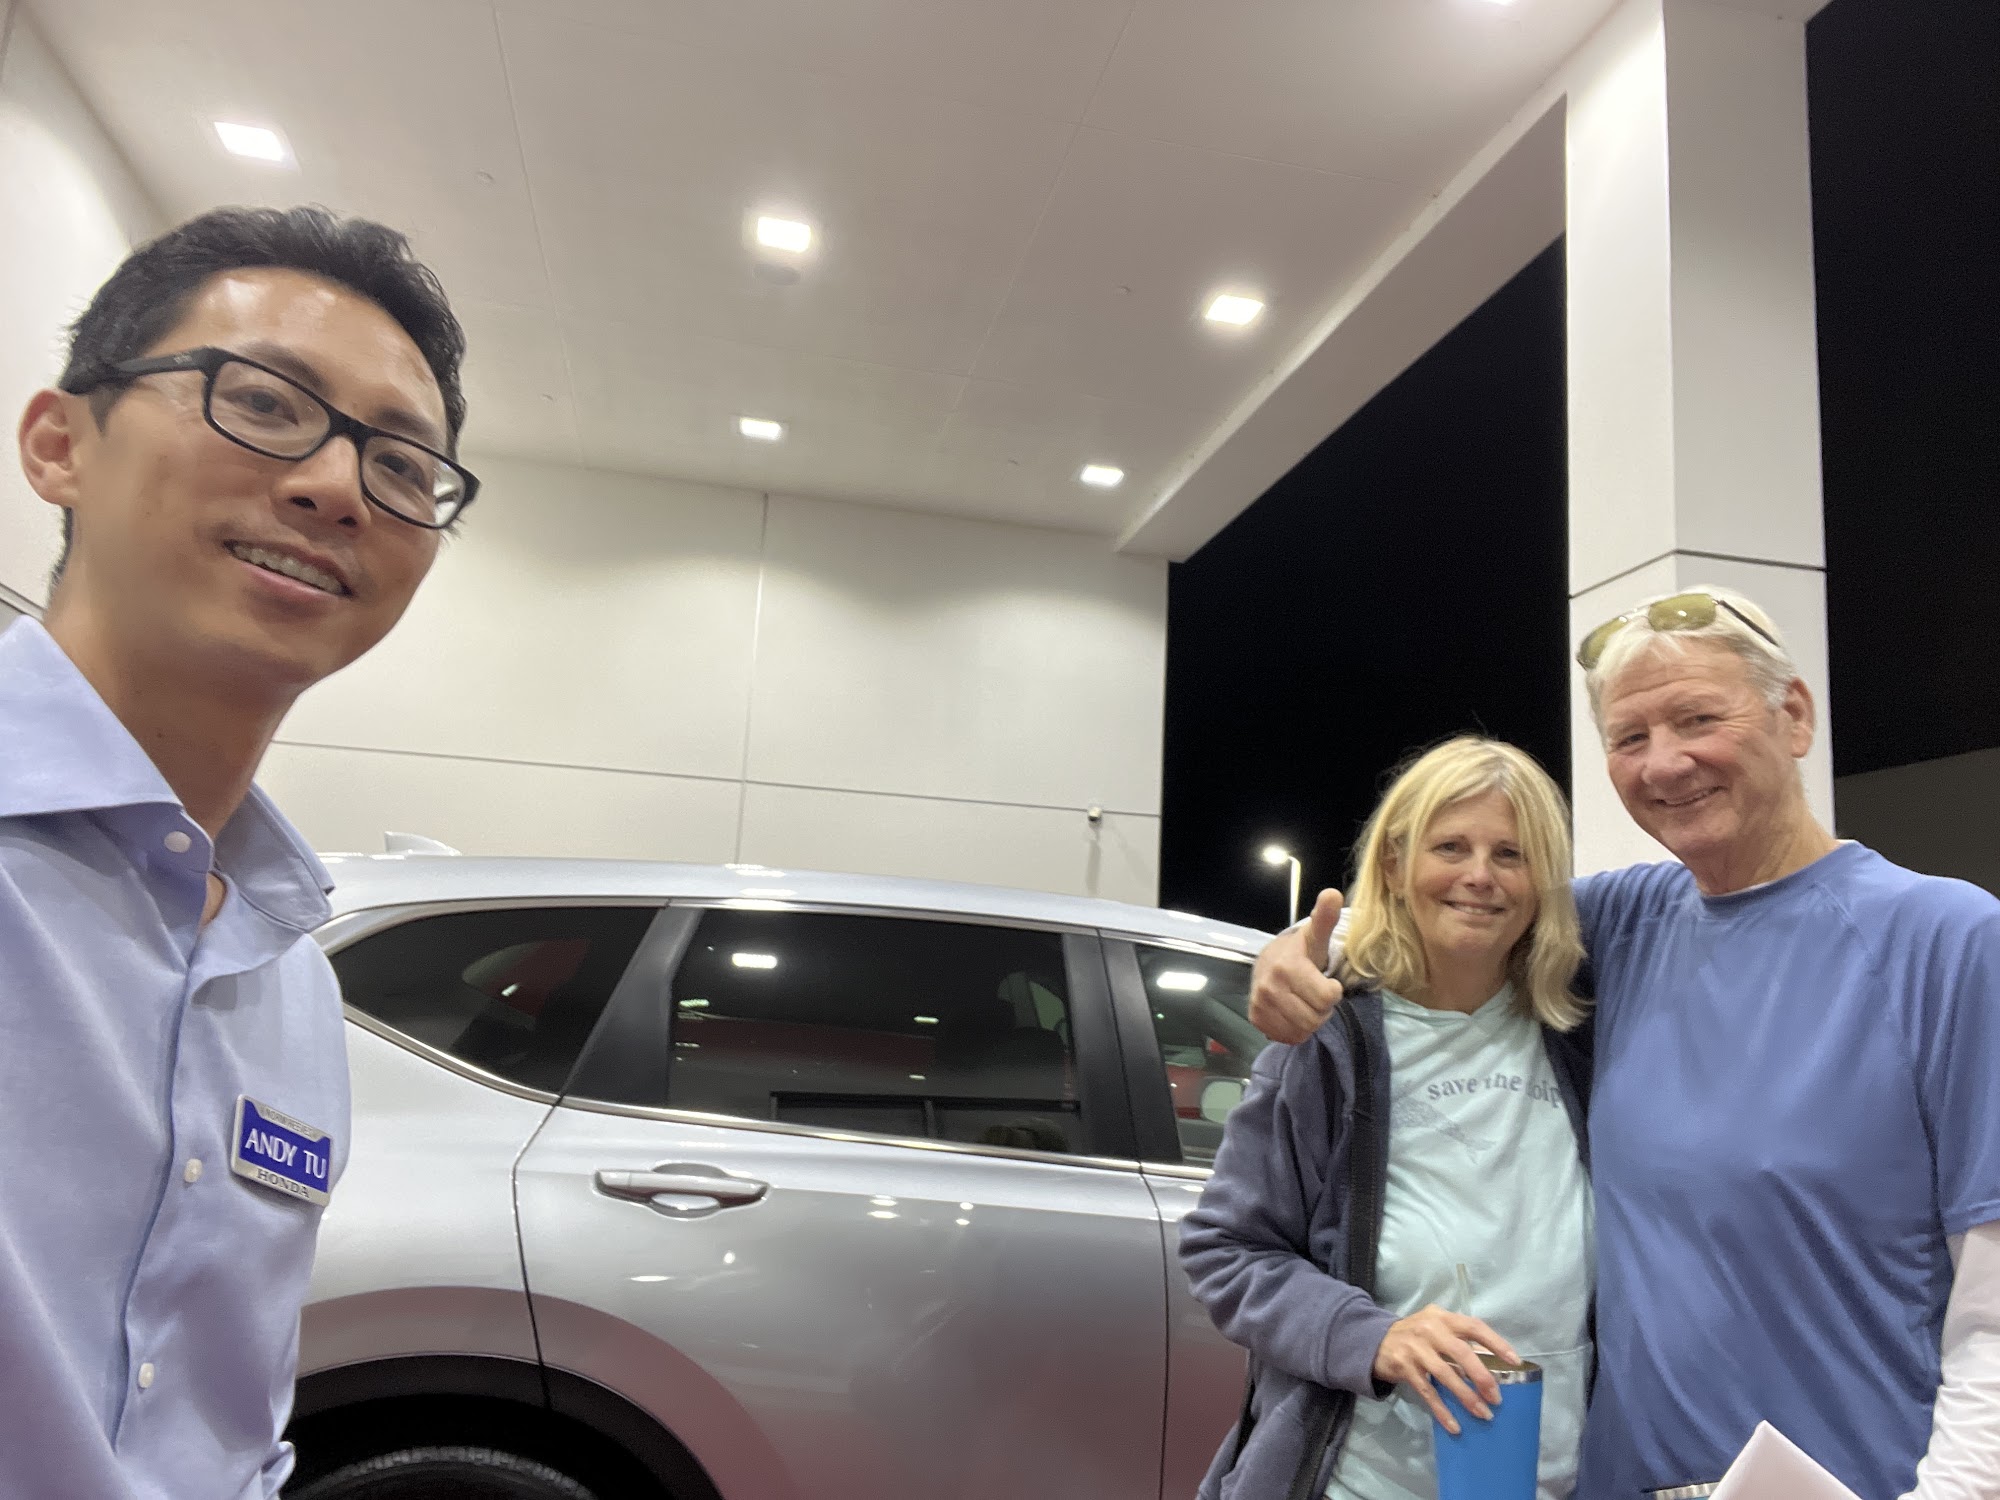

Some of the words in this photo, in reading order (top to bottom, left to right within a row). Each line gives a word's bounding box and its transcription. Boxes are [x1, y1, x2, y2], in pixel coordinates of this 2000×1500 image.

[1427, 1078, 1477, 1100] save
[245, 1128, 298, 1167] ANDY
[303, 1149, 327, 1179] TU
[256, 1168, 310, 1199] HONDA
